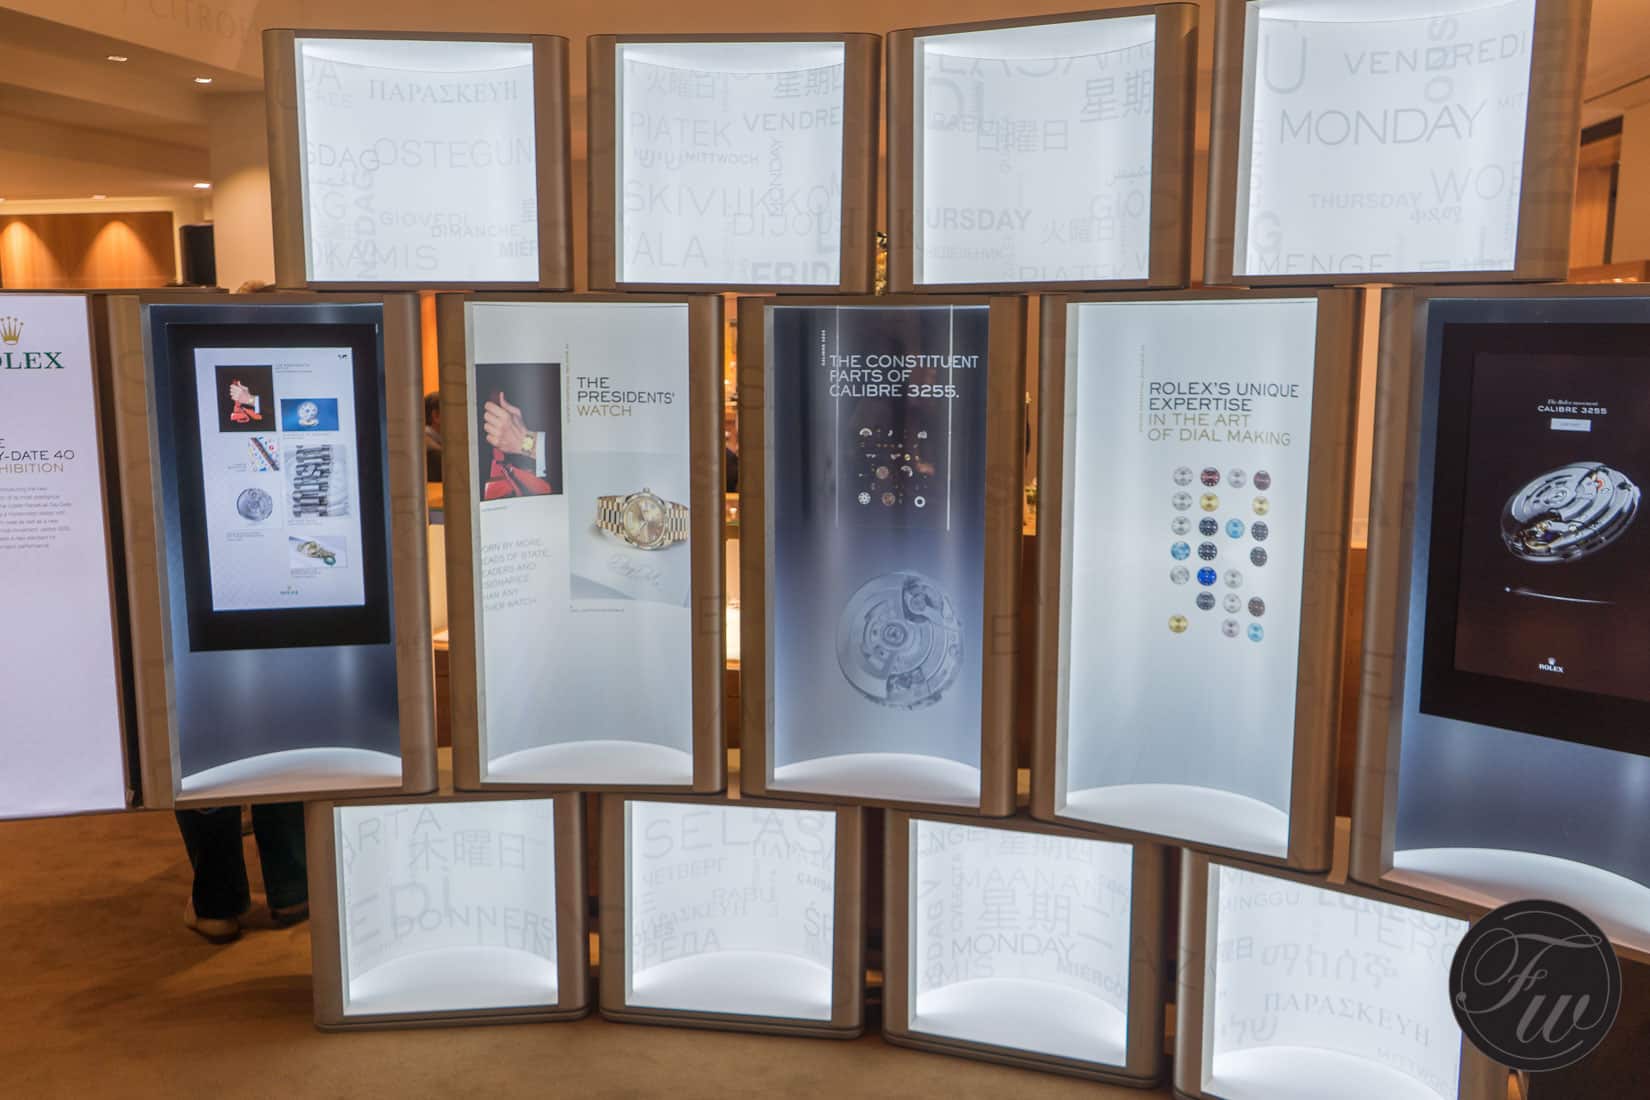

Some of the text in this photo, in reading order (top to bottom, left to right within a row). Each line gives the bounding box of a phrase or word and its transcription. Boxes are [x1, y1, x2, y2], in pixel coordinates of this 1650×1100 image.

[1279, 98, 1488, 147] MONDAY
[1307, 191, 1424, 210] THURSDAY
[0, 352, 65, 370] LEX
[829, 354, 979, 369] THE CONSTITUENT
[576, 376, 610, 389] THE
[829, 370, 912, 382] PARTS OF
[576, 390, 676, 405] PRESIDENTS'
[829, 384, 960, 398] CALIBRE 3255.
[1150, 381, 1299, 399] ROLEX'S UNIQUE
[576, 405, 633, 418] WATCH
[1149, 397, 1253, 412] EXPERTISE
[1537, 405, 1578, 414] CALIBRE
[1149, 413, 1251, 427] IN THE ART
[1148, 428, 1291, 447] OF DIAL MAKING
[53, 449, 76, 461] 40
[1538, 663, 1565, 674] ROLEX
[951, 932, 1076, 963] MONDAY
